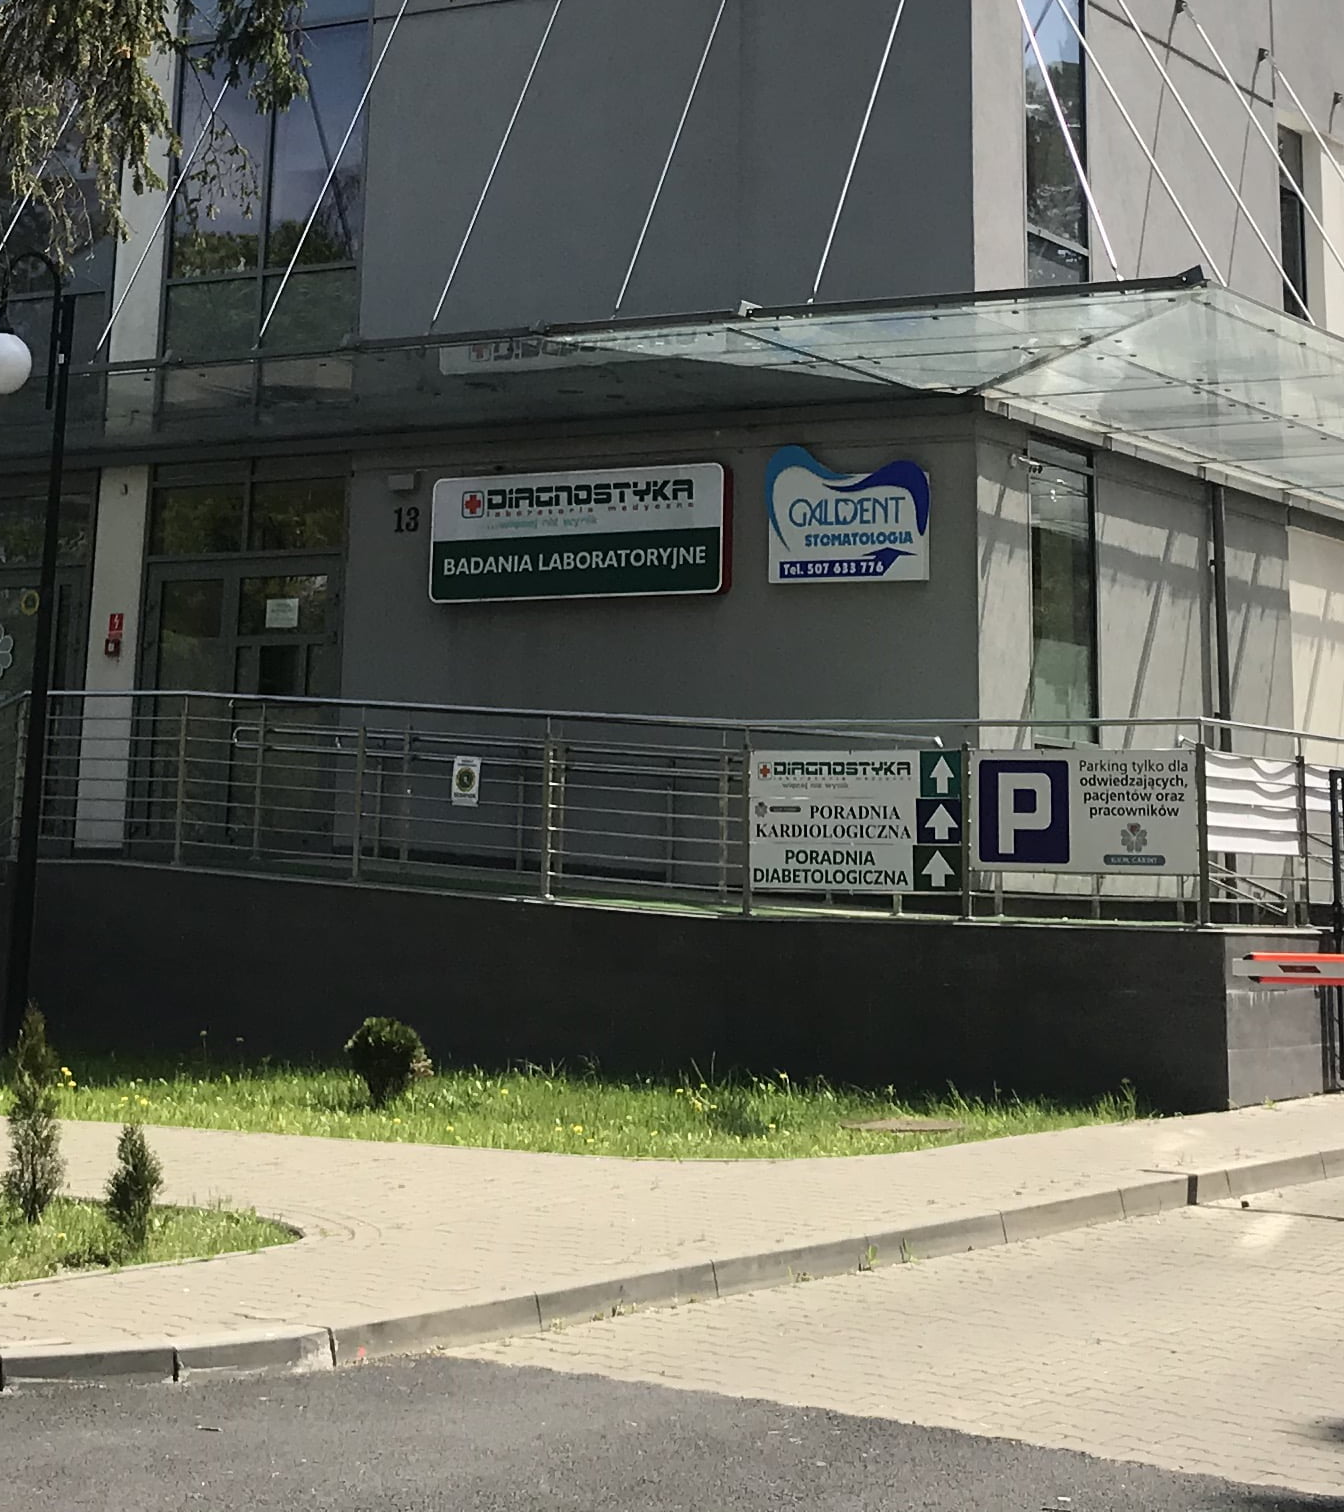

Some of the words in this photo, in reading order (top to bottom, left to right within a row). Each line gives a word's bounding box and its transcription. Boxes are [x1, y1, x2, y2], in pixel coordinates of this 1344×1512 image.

[788, 496, 906, 527] GALDENT
[393, 506, 420, 534] 13
[804, 531, 913, 547] STOMATOLOGIA
[443, 554, 533, 576] BADANIA
[539, 546, 706, 571] LABORATORYJNE
[783, 563, 804, 575] Tel.
[807, 563, 829, 574] 507
[833, 562, 856, 574] 633
[860, 561, 884, 573] 776
[1079, 760, 1128, 775] Parking
[1132, 760, 1164, 775] tylko
[1168, 760, 1189, 772] dla
[1079, 775, 1188, 790] odwiedzających,
[1083, 789, 1152, 805] pacjentów
[1156, 792, 1185, 802] oraz
[810, 805, 901, 820] PORADNIA
[998, 772, 1052, 854] P
[1089, 804, 1180, 818] pracowników
[756, 823, 912, 839] KARDIOLOGICZNA
[784, 850, 875, 865] PORADNIA
[753, 868, 908, 886] DIABETOLOGICZNA
